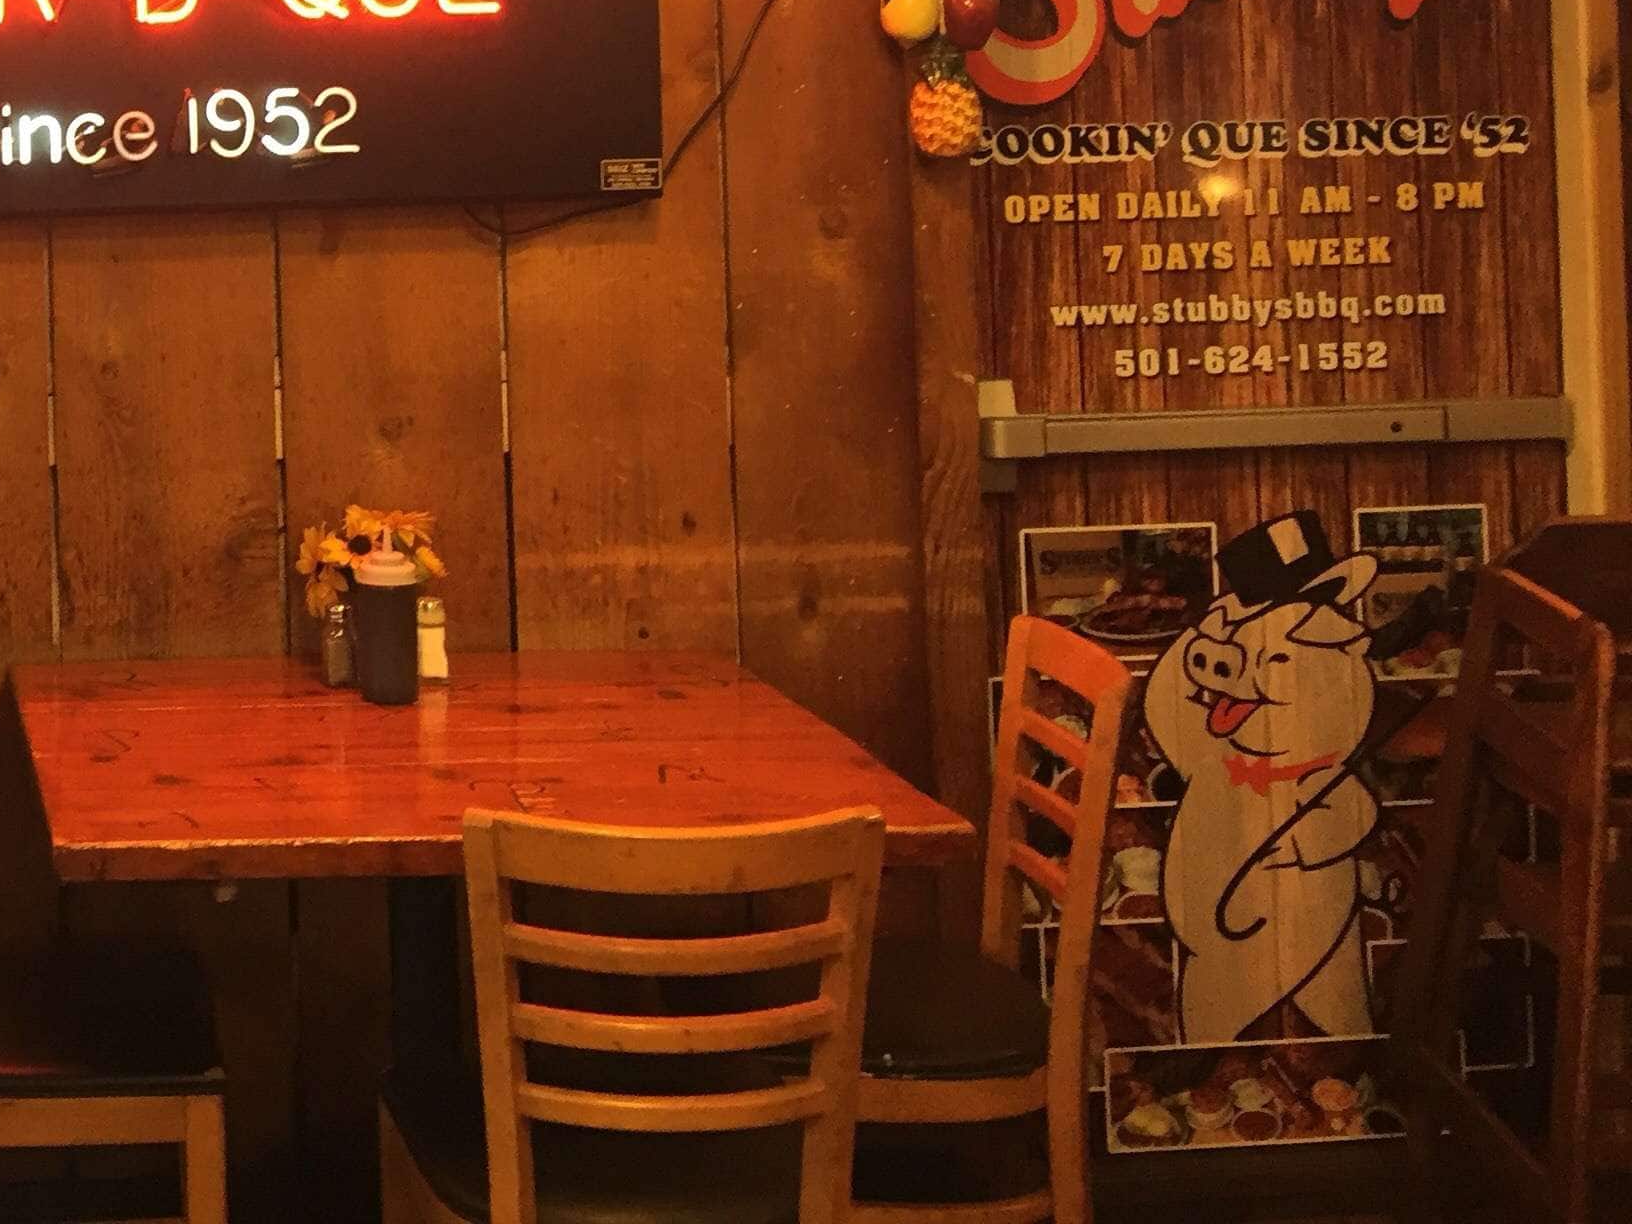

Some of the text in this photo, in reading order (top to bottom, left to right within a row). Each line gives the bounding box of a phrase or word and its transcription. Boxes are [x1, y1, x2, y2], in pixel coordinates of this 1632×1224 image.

[186, 86, 362, 156] 1952
[1181, 118, 1288, 167] QUE
[1297, 115, 1451, 156] SINCE
[1004, 192, 1101, 224] OPEN
[1116, 185, 1221, 220] DAILY
[1300, 185, 1351, 214] AM
[1395, 184, 1419, 212] 8
[1433, 181, 1485, 210] PM
[1103, 235, 1392, 272] 7 DAYS A WEEK
[1050, 292, 1447, 327] www.stubbysbbq.com
[1114, 341, 1389, 377] 501-624-1552
